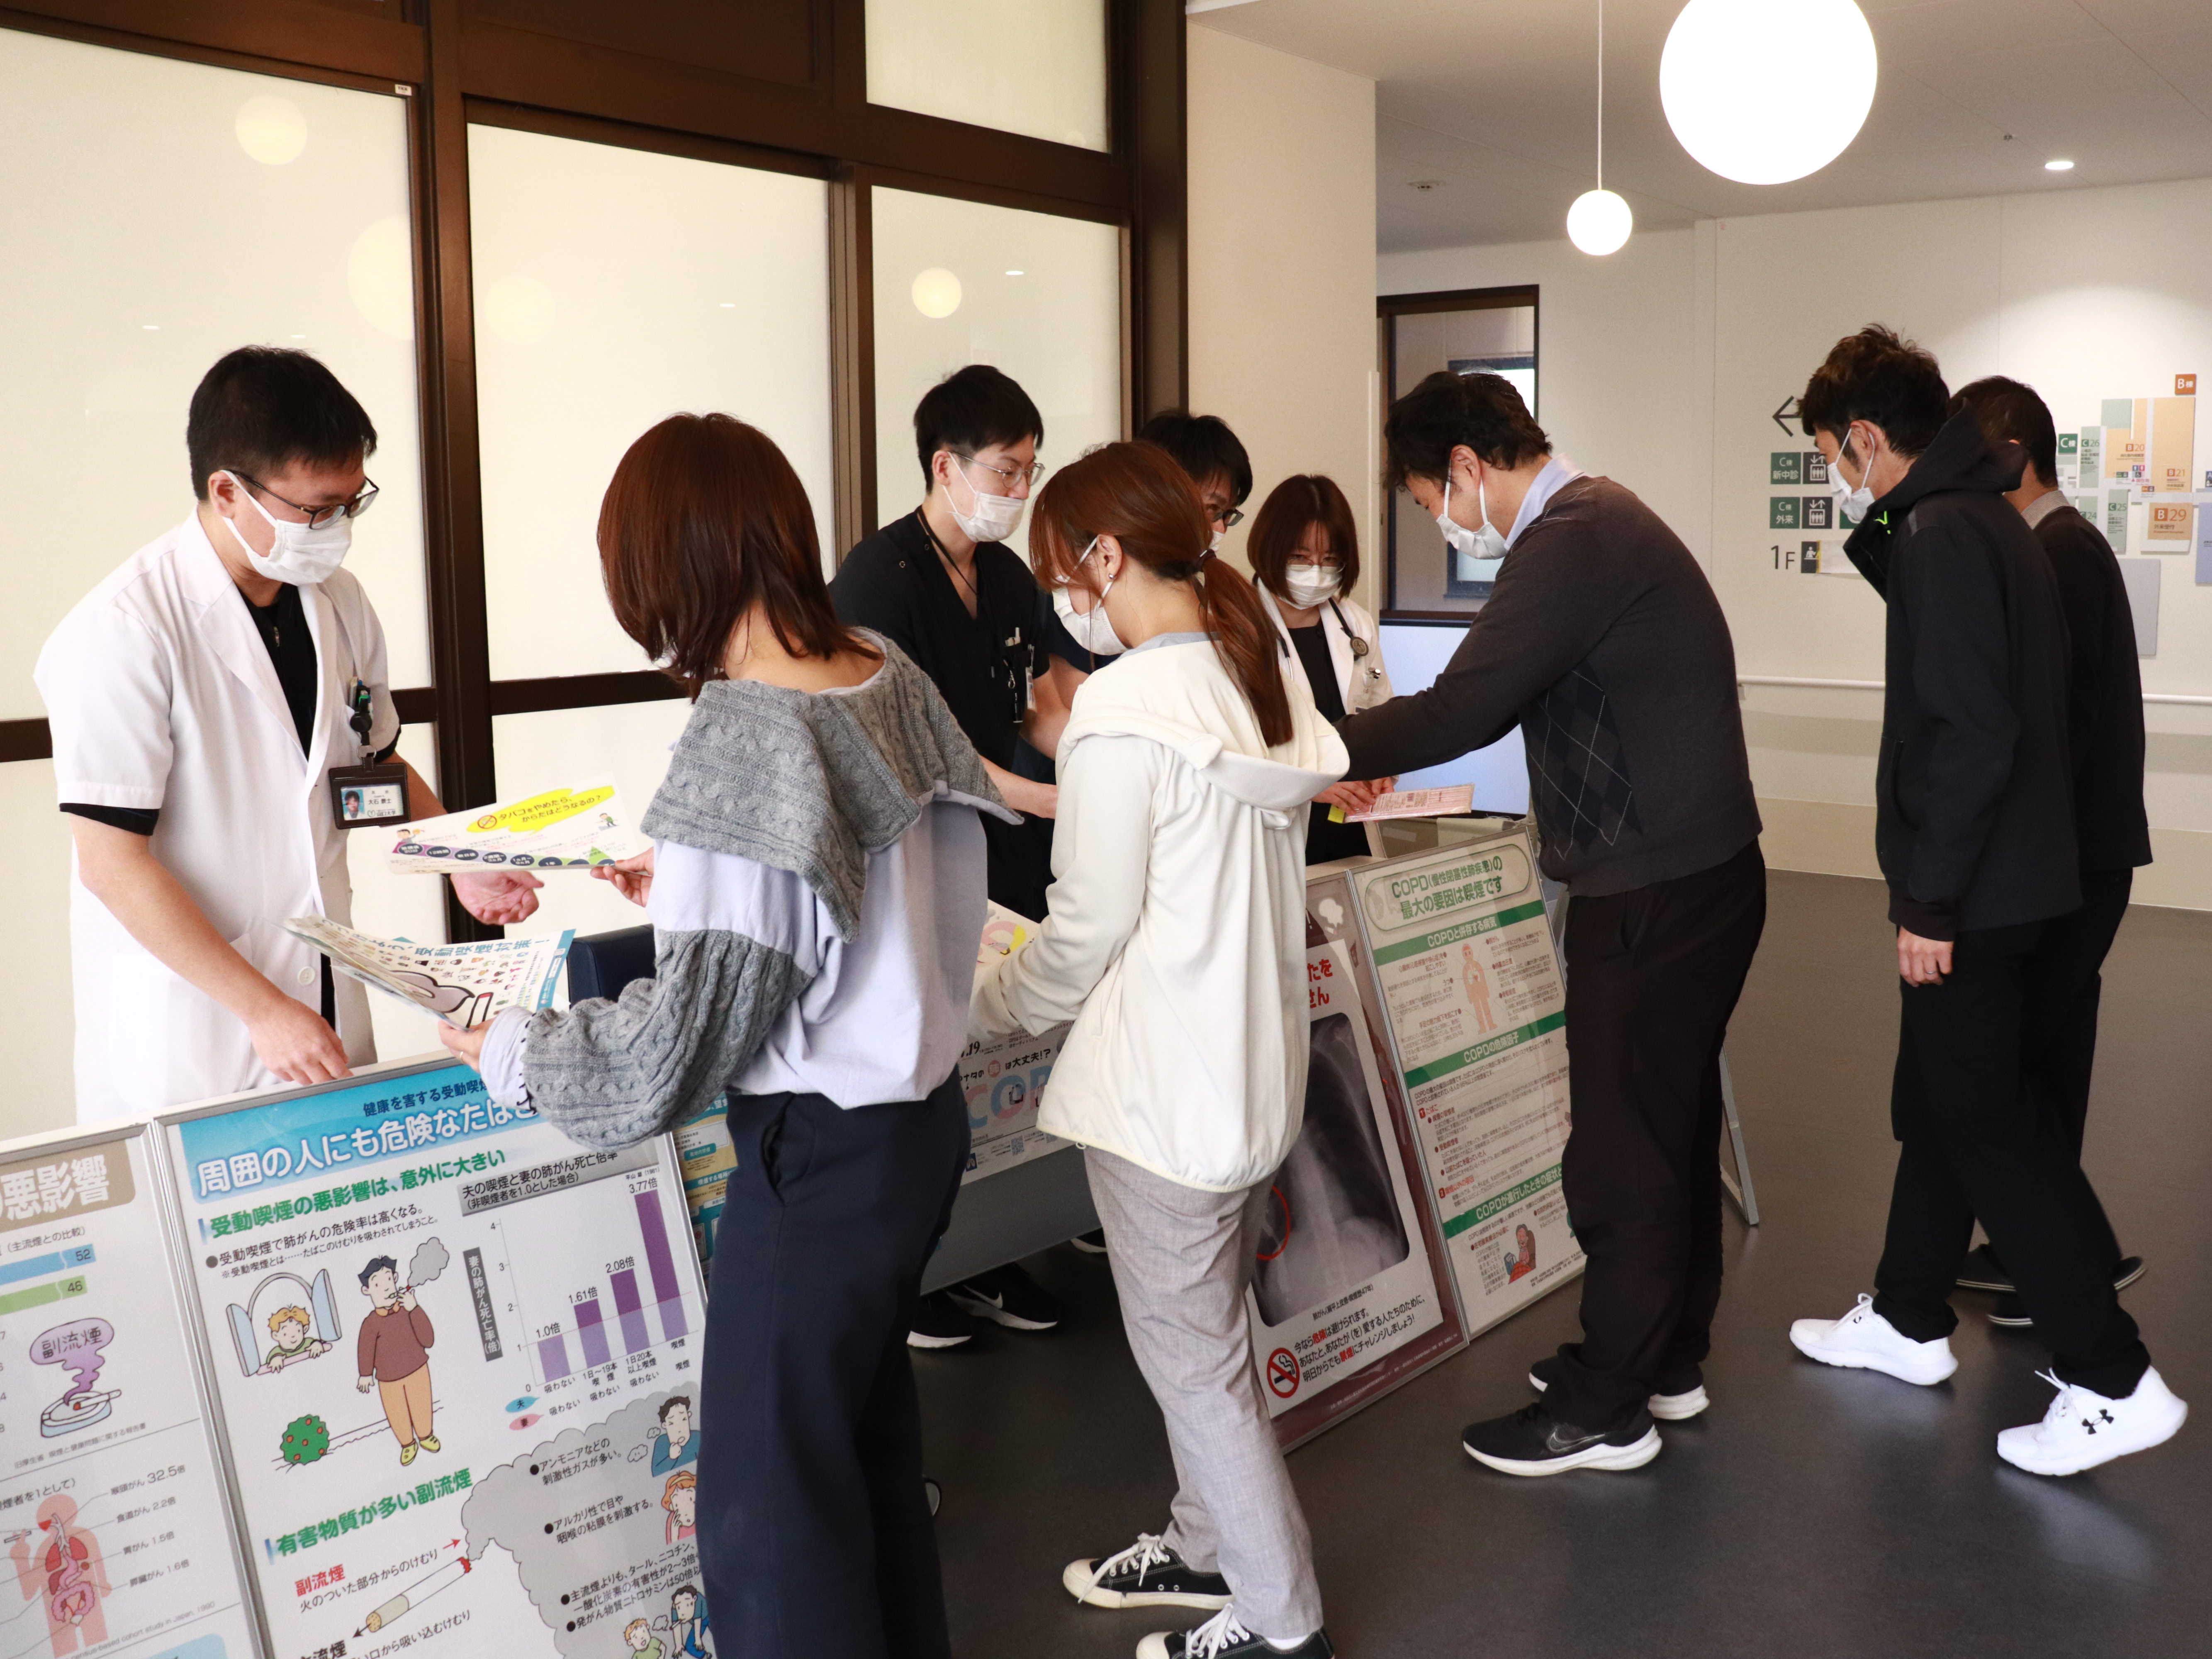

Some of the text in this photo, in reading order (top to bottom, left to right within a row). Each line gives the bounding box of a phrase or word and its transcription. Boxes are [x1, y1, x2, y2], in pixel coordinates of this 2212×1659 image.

[2177, 378, 2193, 389] B棟
[1776, 515, 1793, 524] 外来
[1771, 545, 1795, 569] 1F
[1400, 876, 1503, 920] 最大の要因は喫煙です
[1427, 916, 1498, 948] COPDと併存する病気
[1463, 1031, 1519, 1063] COPDの危険因子
[0, 1154, 110, 1221] 悪影響
[210, 1149, 506, 1239] 受動喫煙の悪影響は、意外に大きい
[628, 1178, 659, 1194] 3.77倍
[490, 1221, 496, 1231] 4
[75, 1249, 91, 1262] 52
[606, 1256, 635, 1274] 2.08倍
[499, 1262, 505, 1272] 3
[67, 1281, 83, 1293] 46
[568, 1286, 599, 1304] 1.61倍
[468, 1256, 501, 1356] 妻の肺がん死亡率(倍)
[507, 1303, 514, 1312] 2
[535, 1322, 561, 1339] 1.0倍
[1294, 1308, 1370, 1354] 今なら危険は避けられます。
[41, 1326, 102, 1360] 副流煙
[516, 1343, 522, 1352] 1
[625, 1350, 653, 1366] 1日20本
[627, 1357, 658, 1374] 以上喫煙
[525, 1384, 531, 1393] 0
[544, 1377, 576, 1394] 吸わない
[630, 1371, 659, 1387] 吸わない
[589, 1385, 621, 1402] 吸わない
[516, 1399, 525, 1409] 夫
[549, 1399, 581, 1416] 吸わない
[539, 1438, 610, 1472] アンモニアなどの
[146, 1464, 186, 1484] 32.5倍
[542, 1449, 622, 1486] 刺激性ガスが多い。
[116, 1496, 176, 1522] 食道がん 2.2倍
[275, 1467, 473, 1557] 有害物質が多い副流煙
[553, 1495, 623, 1530] アルカリ性で目や
[556, 1498, 654, 1544] 咽喉の粘膜を刺激する。
[123, 1531, 175, 1555] 胃がん 1.5倍
[167, 1559, 190, 1574] 1.6倍
[569, 1543, 695, 1603] 主流煙よりも、タール、ニコチン、
[294, 1564, 346, 1597] 副流煙
[300, 1549, 438, 1613] 火のついた部分からのけむり
[122, 1629, 144, 1642] cohort
[145, 1622, 164, 1634] study
